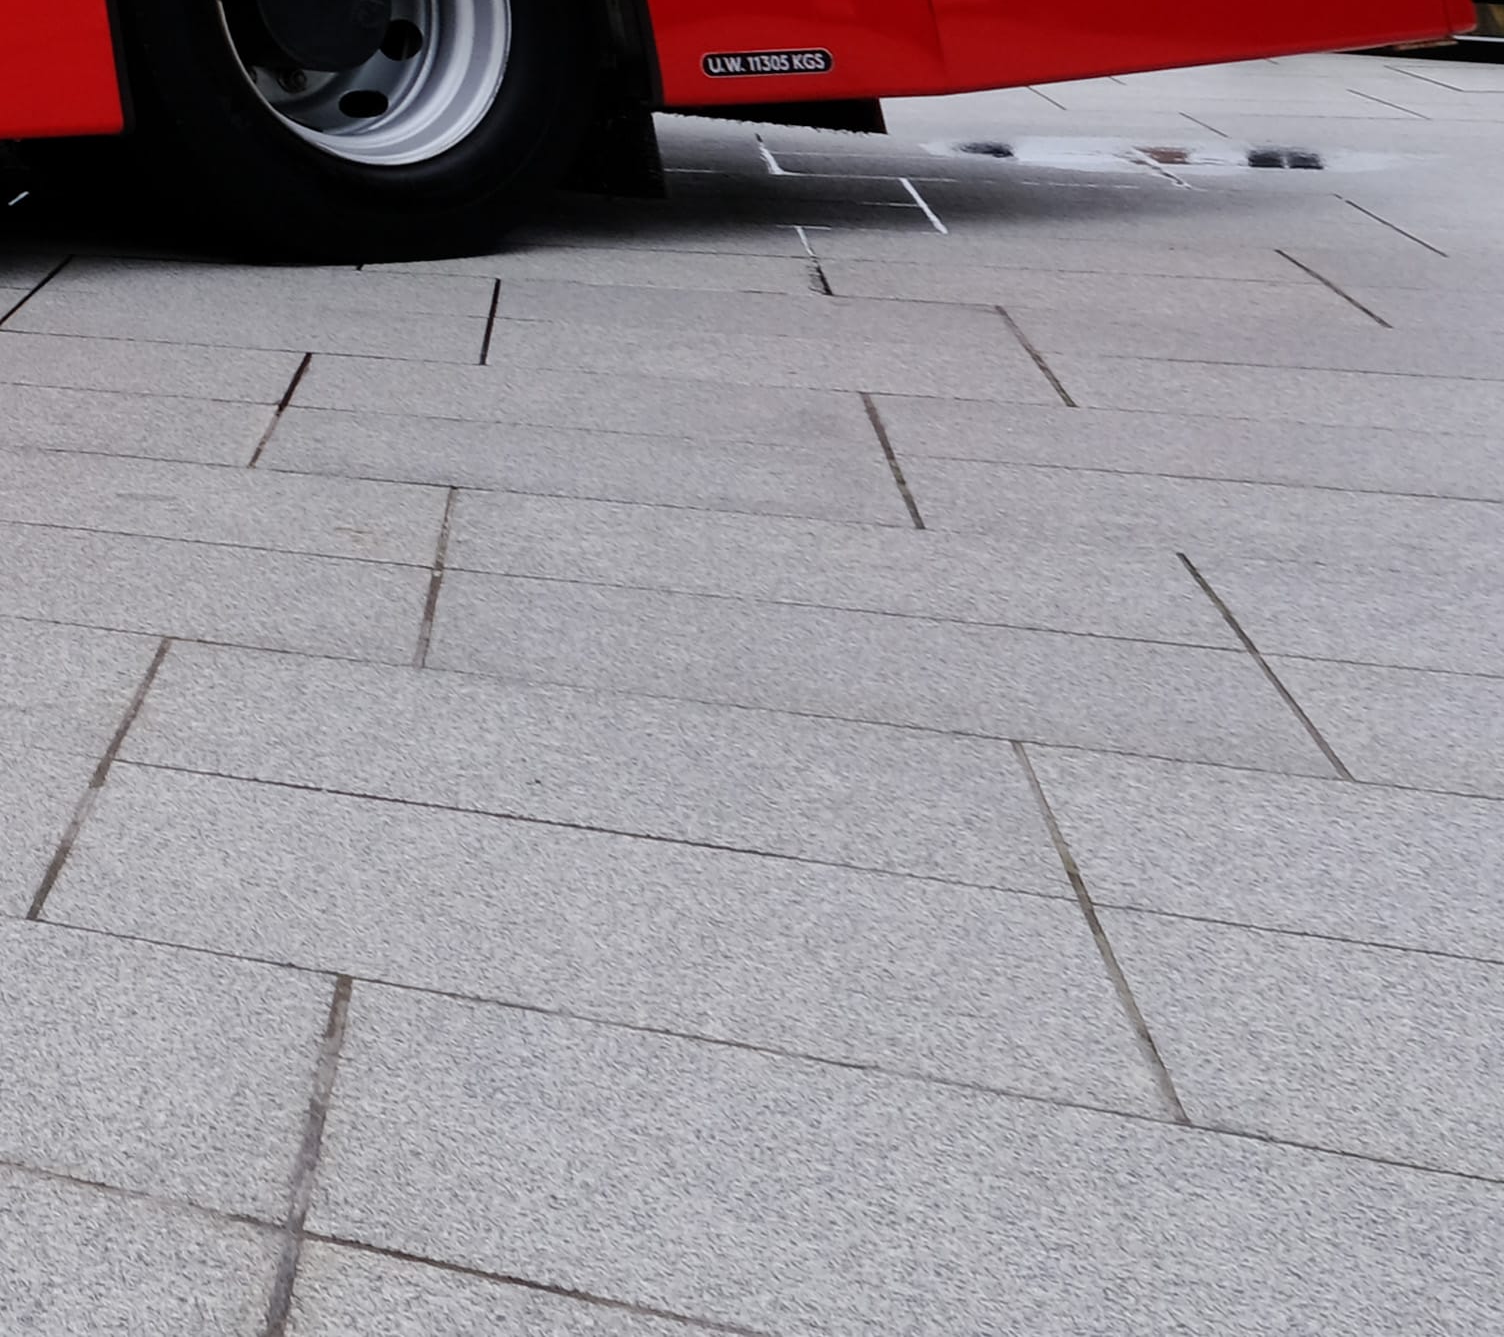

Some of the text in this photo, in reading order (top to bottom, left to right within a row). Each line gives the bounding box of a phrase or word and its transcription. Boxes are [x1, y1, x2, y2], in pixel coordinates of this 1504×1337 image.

[707, 53, 826, 73] U.W. 11305 KGS
